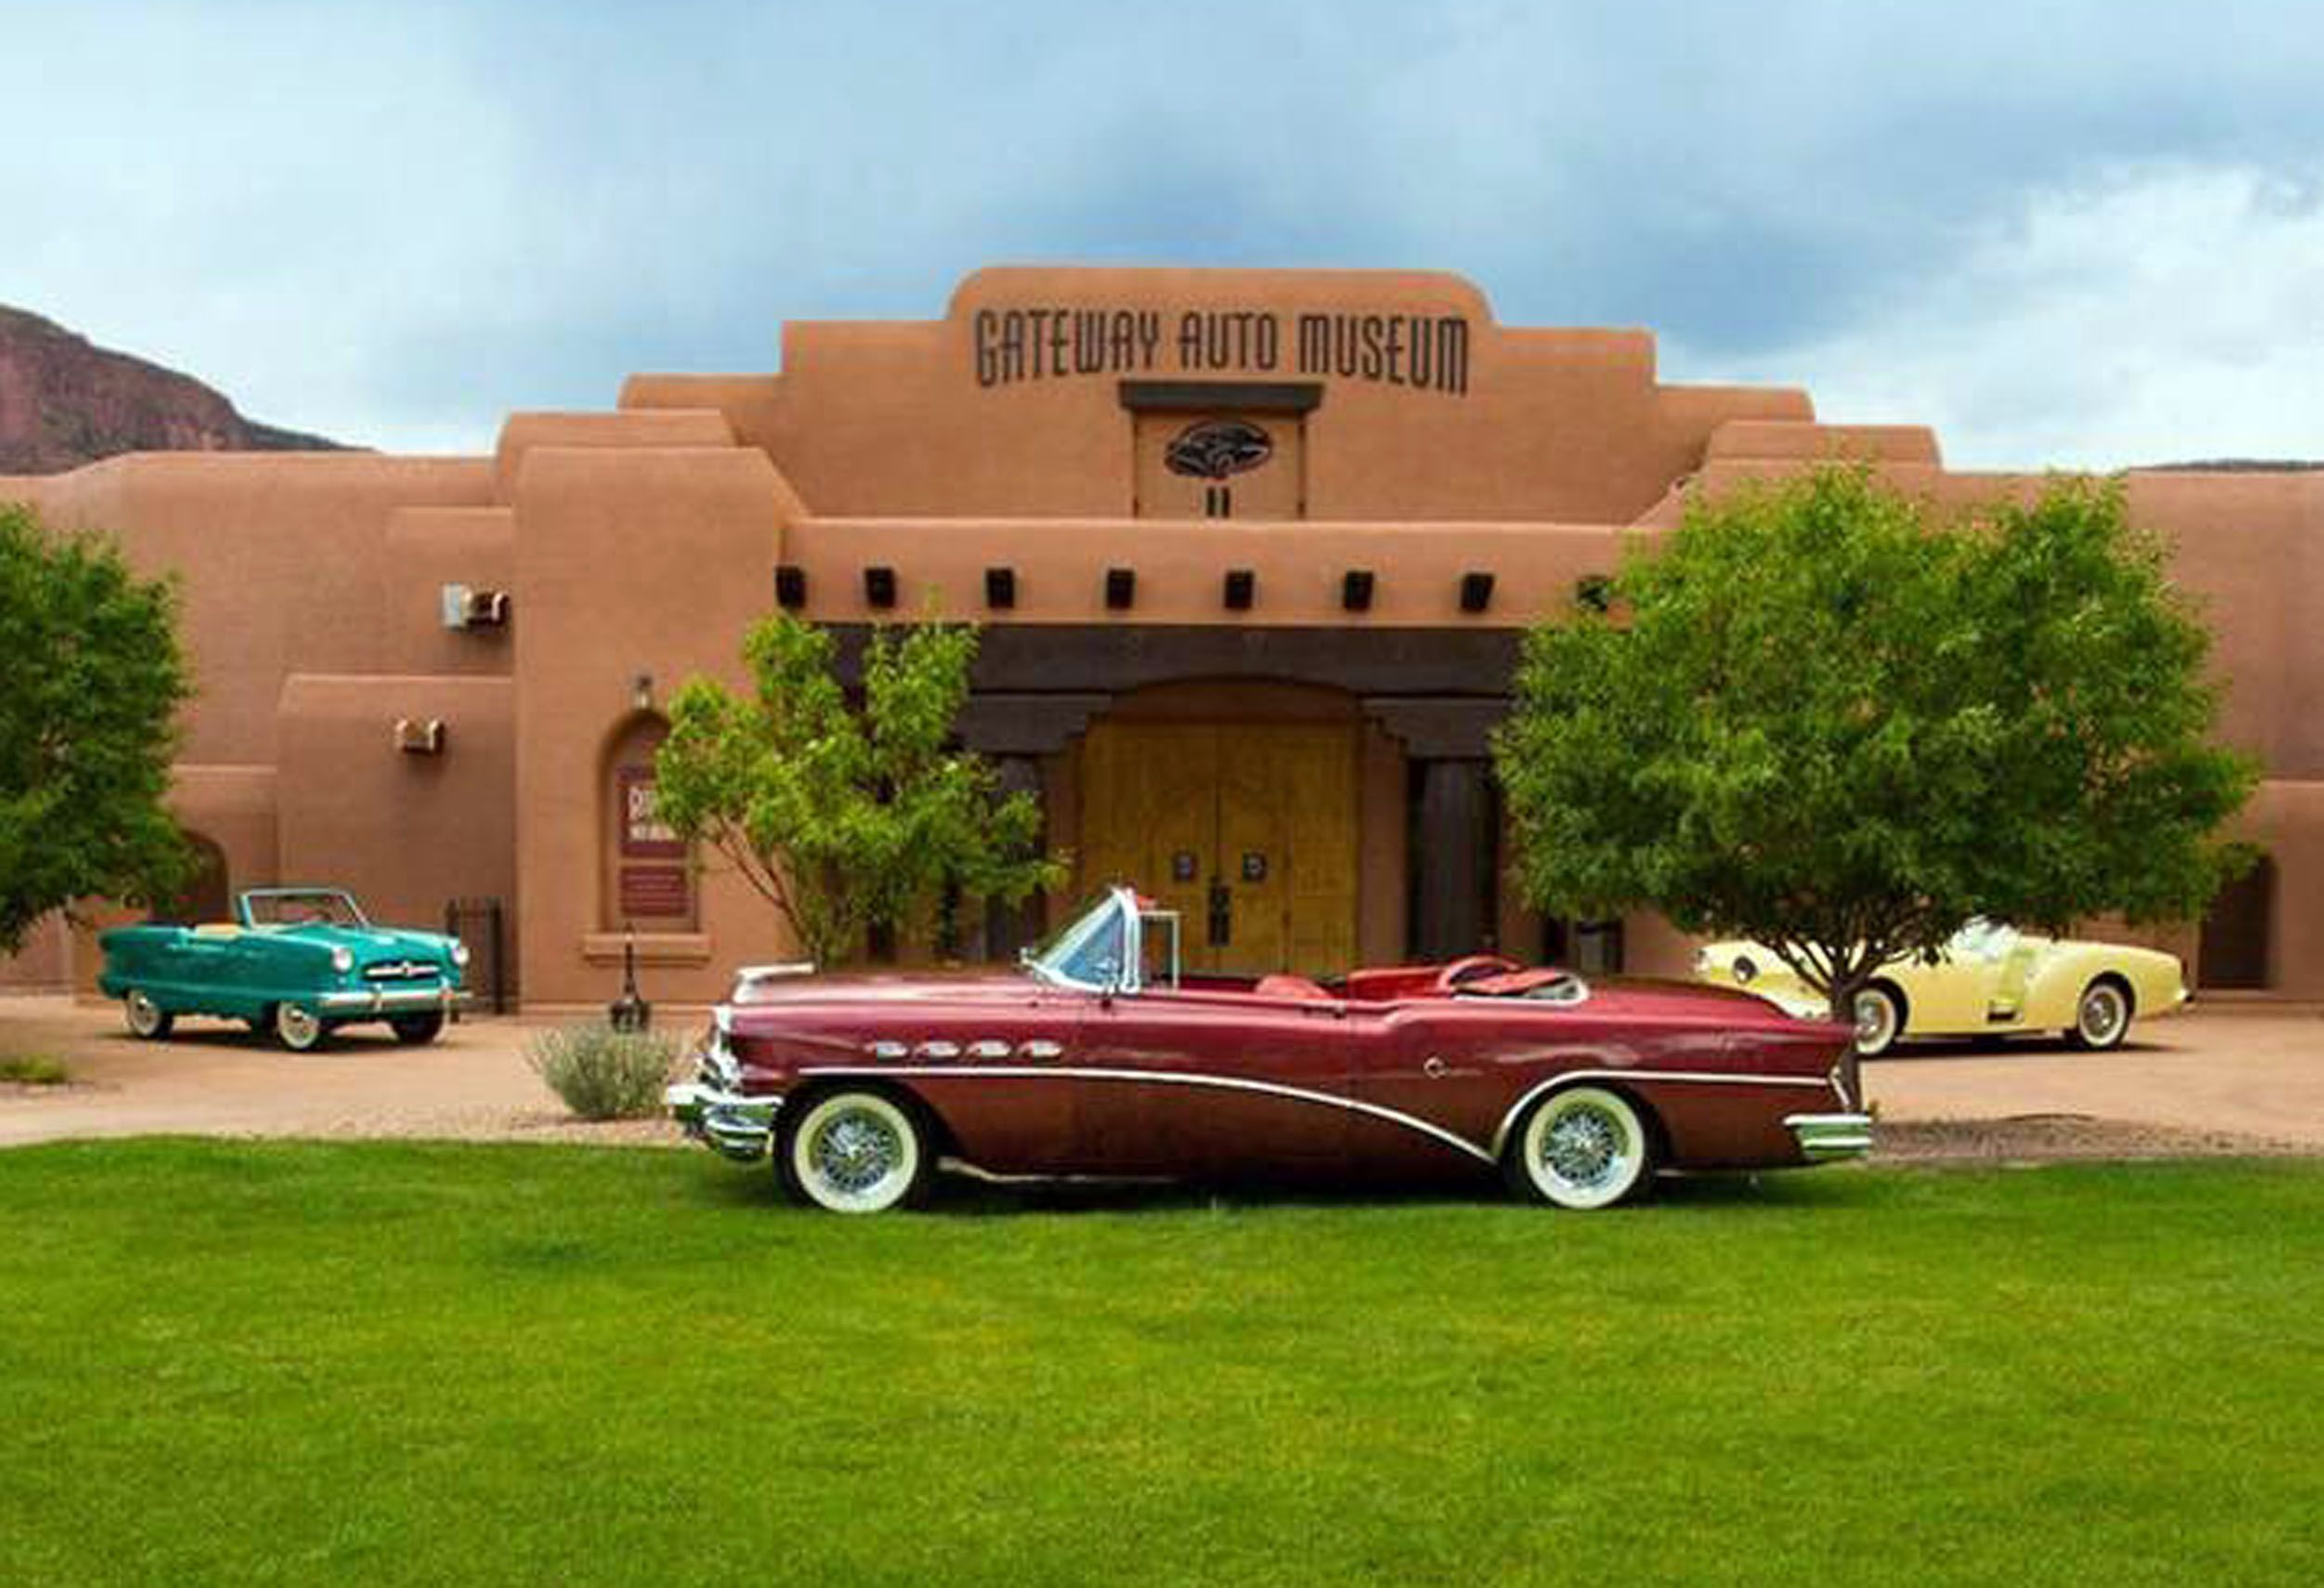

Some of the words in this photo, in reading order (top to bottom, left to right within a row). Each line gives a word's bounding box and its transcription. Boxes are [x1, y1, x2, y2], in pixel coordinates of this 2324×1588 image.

[976, 310, 1159, 387] GATEWAY
[1179, 311, 1276, 369] AUTO
[1299, 314, 1468, 394] MUSEUM
